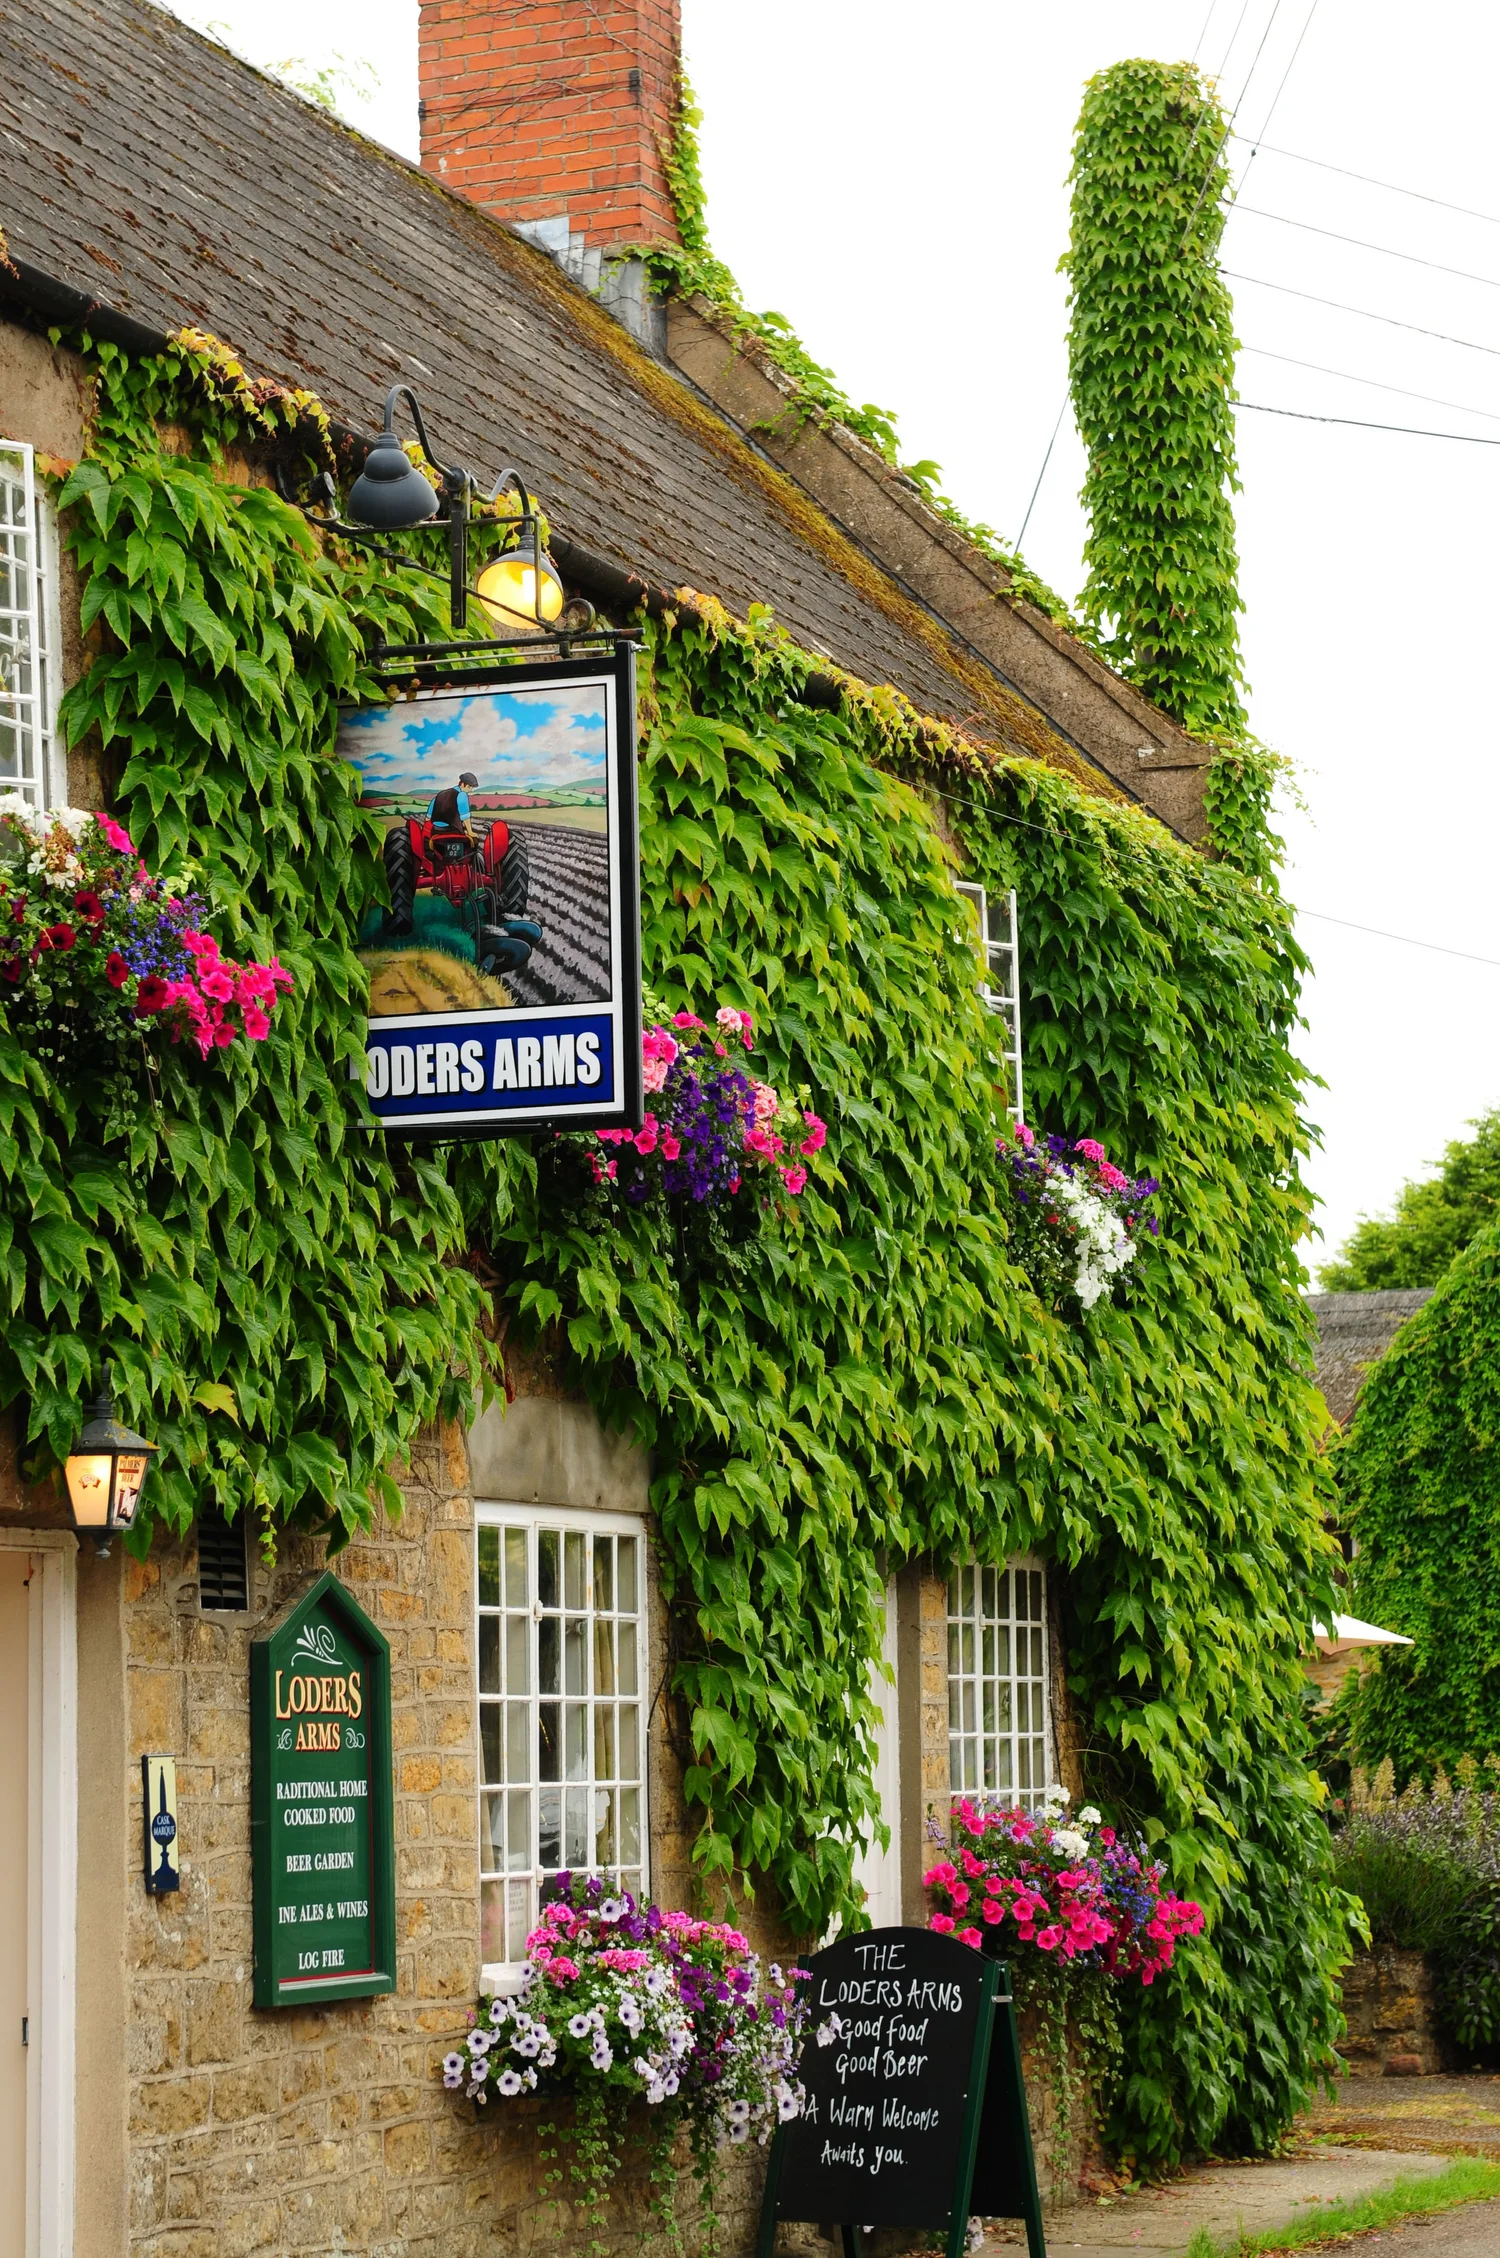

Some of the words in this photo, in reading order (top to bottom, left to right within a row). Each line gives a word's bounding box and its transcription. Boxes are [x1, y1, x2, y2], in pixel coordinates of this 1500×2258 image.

[350, 1040, 485, 1098] ODERS
[492, 1032, 600, 1090] ARMS
[275, 1670, 362, 1720] LODERS
[295, 1722, 340, 1752] ARMS
[276, 1780, 338, 1800] RADITIONAL
[339, 1779, 368, 1797] HOME
[156, 1815, 171, 1825] CASK
[284, 1807, 327, 1826] COOKED
[329, 1806, 355, 1824] FOOD
[154, 1825, 175, 1836] MARQUE
[286, 1854, 312, 1873] BEER
[314, 1851, 354, 1871] GARDEN
[278, 1905, 297, 1924] INE
[299, 1903, 324, 1922] ALES
[326, 1903, 334, 1920] &
[337, 1900, 368, 1919] WINES
[298, 1951, 319, 1970] LOG
[322, 1949, 345, 1967] FIRE
[854, 1944, 906, 1972] THE
[819, 1978, 903, 2009] LODERS
[906, 1978, 963, 2013] ARMS
[838, 2015, 884, 2050] Good
[835, 2046, 880, 2085] Good
[882, 2050, 928, 2080] Beer
[805, 2093, 820, 2125] A
[830, 2095, 874, 2132] Warm
[882, 2097, 939, 2132] Welcome
[820, 2139, 865, 2168] Awaits
